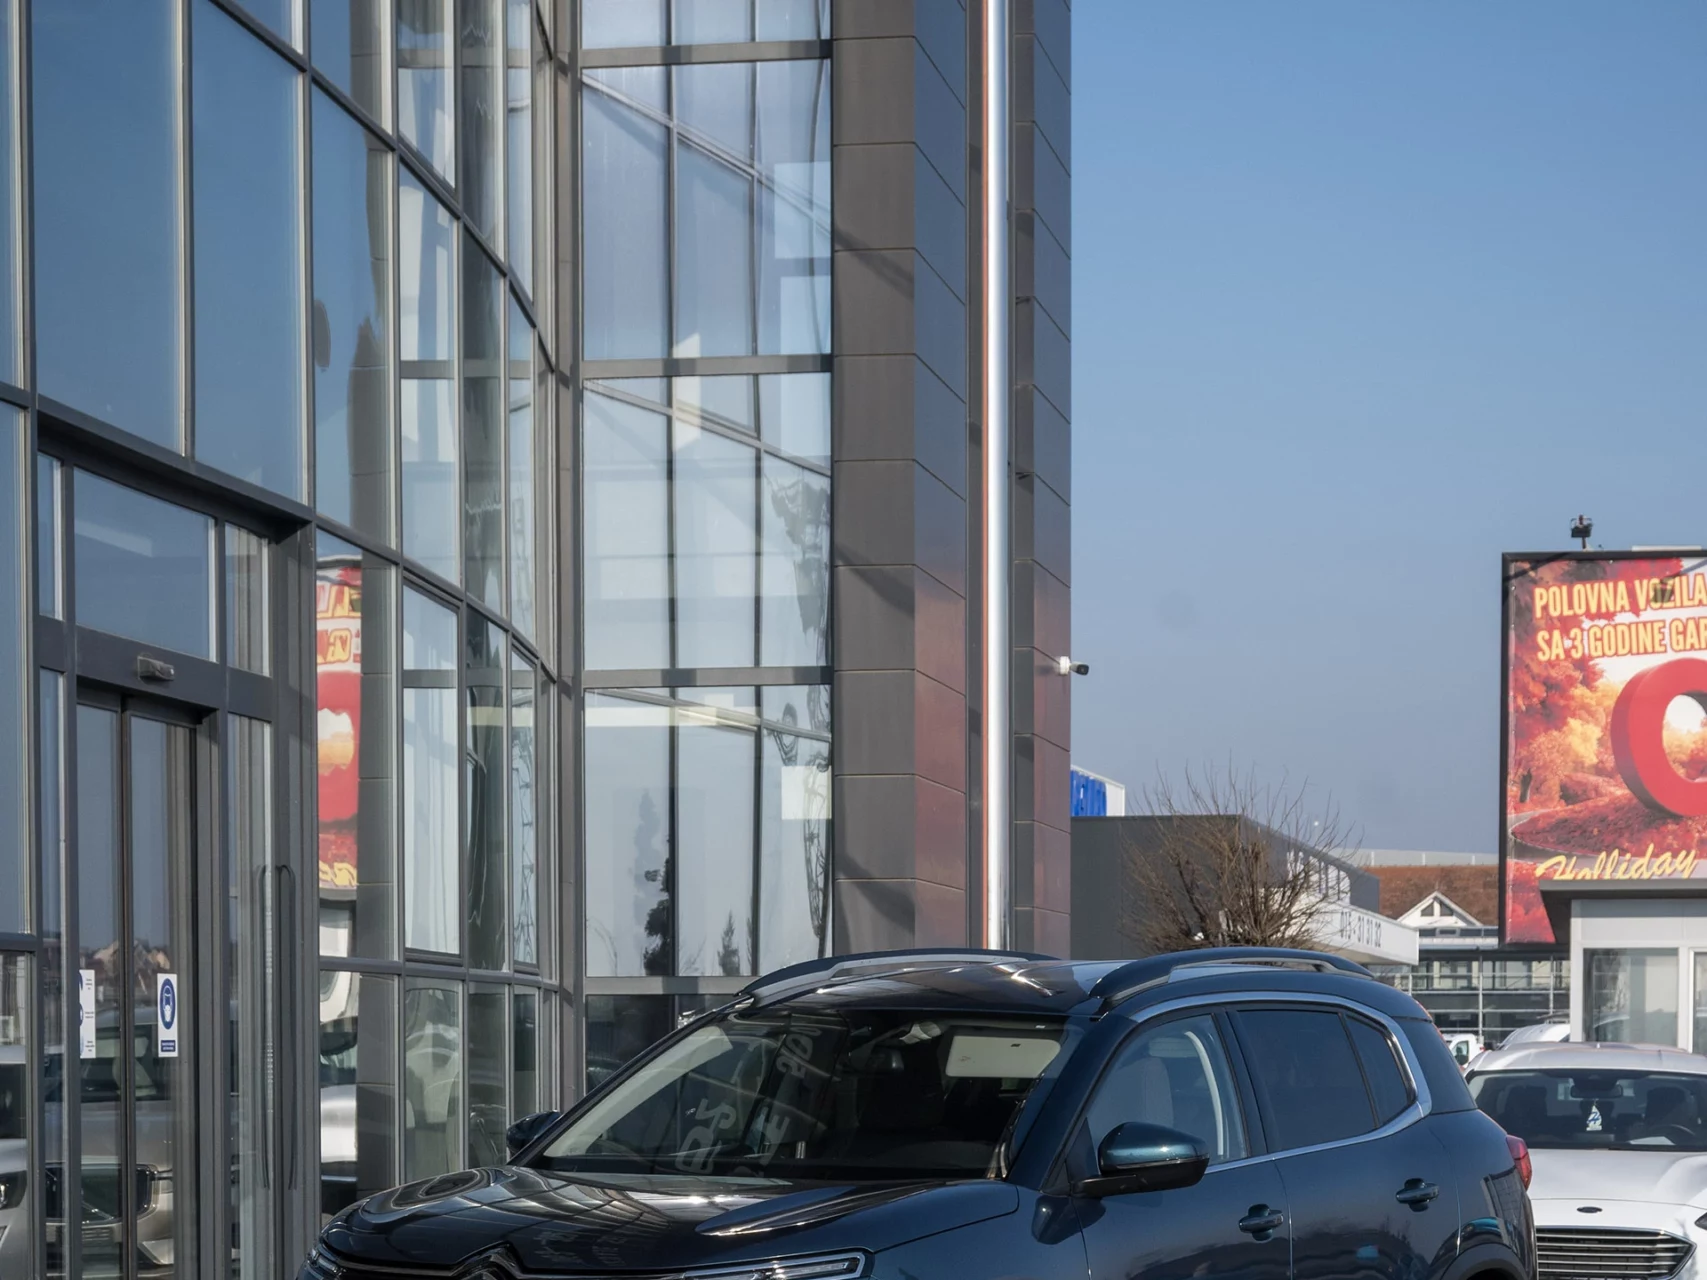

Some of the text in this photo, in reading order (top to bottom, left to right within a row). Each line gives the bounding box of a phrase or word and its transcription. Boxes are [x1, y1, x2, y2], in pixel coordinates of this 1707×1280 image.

[1533, 573, 1707, 619] POLOVNA VOZILA
[1536, 628, 1565, 662] SA
[1569, 627, 1583, 659] 3
[1587, 621, 1667, 658] GODINE
